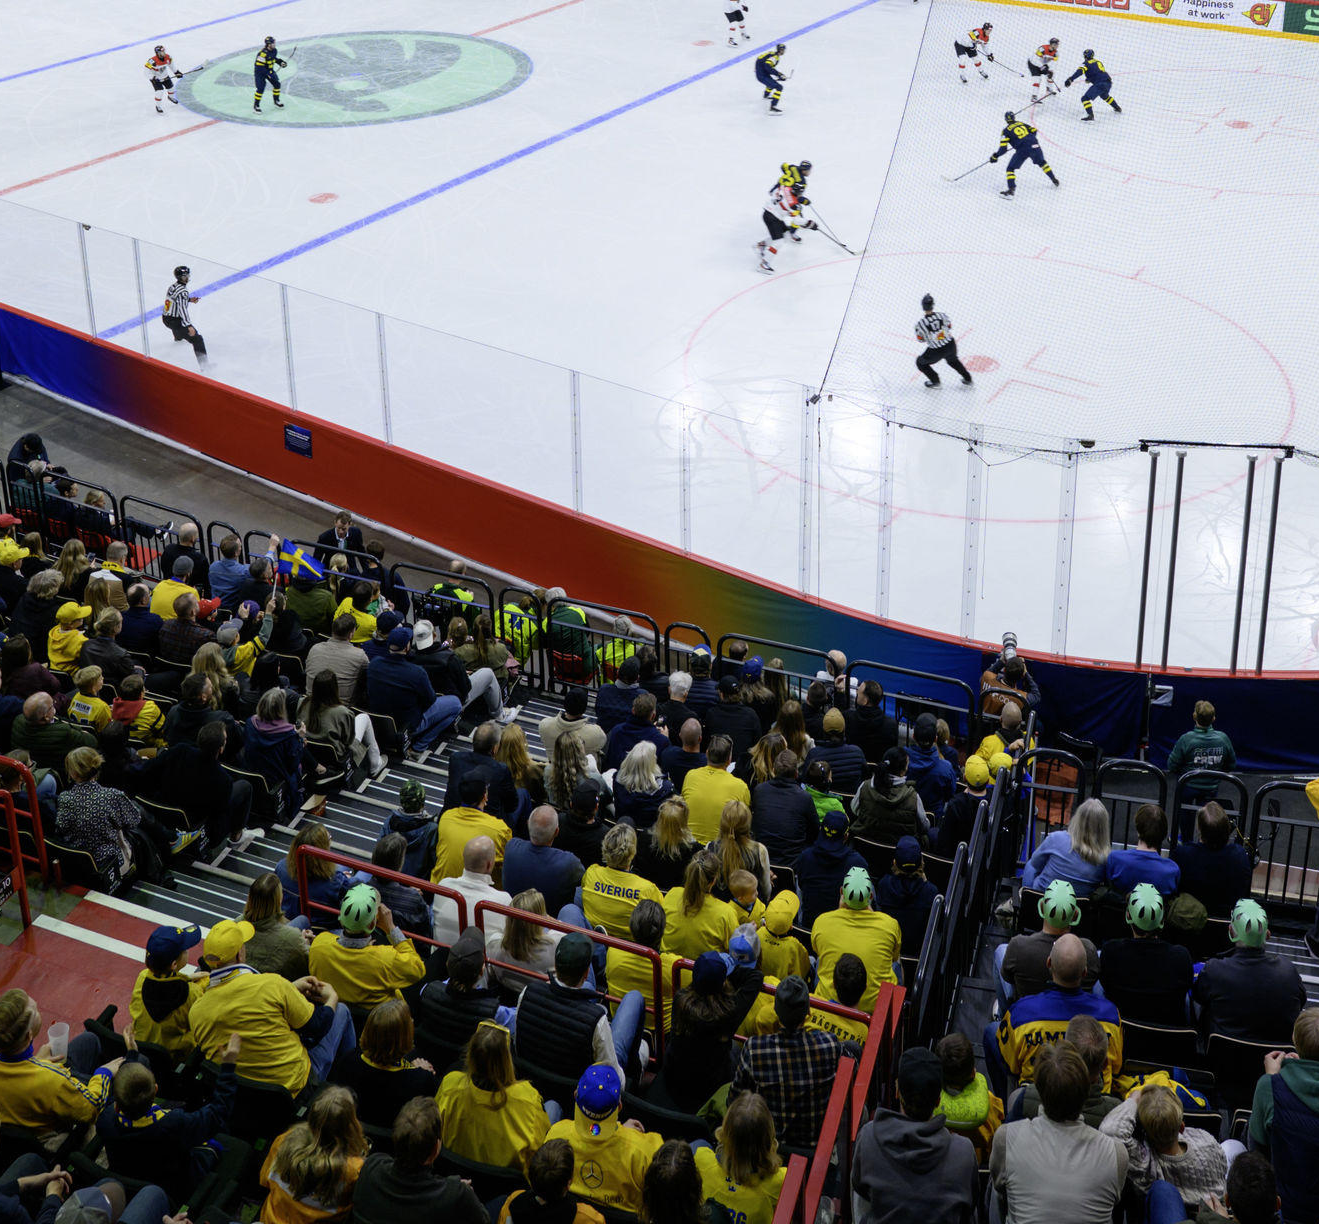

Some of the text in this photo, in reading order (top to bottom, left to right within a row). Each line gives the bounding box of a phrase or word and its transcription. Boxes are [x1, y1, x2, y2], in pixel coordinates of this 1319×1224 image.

[1187, 7, 1198, 18] at
[1194, 756, 1223, 765] CREW
[2, 877, 11, 890] 10
[593, 881, 640, 900] SVERIGE
